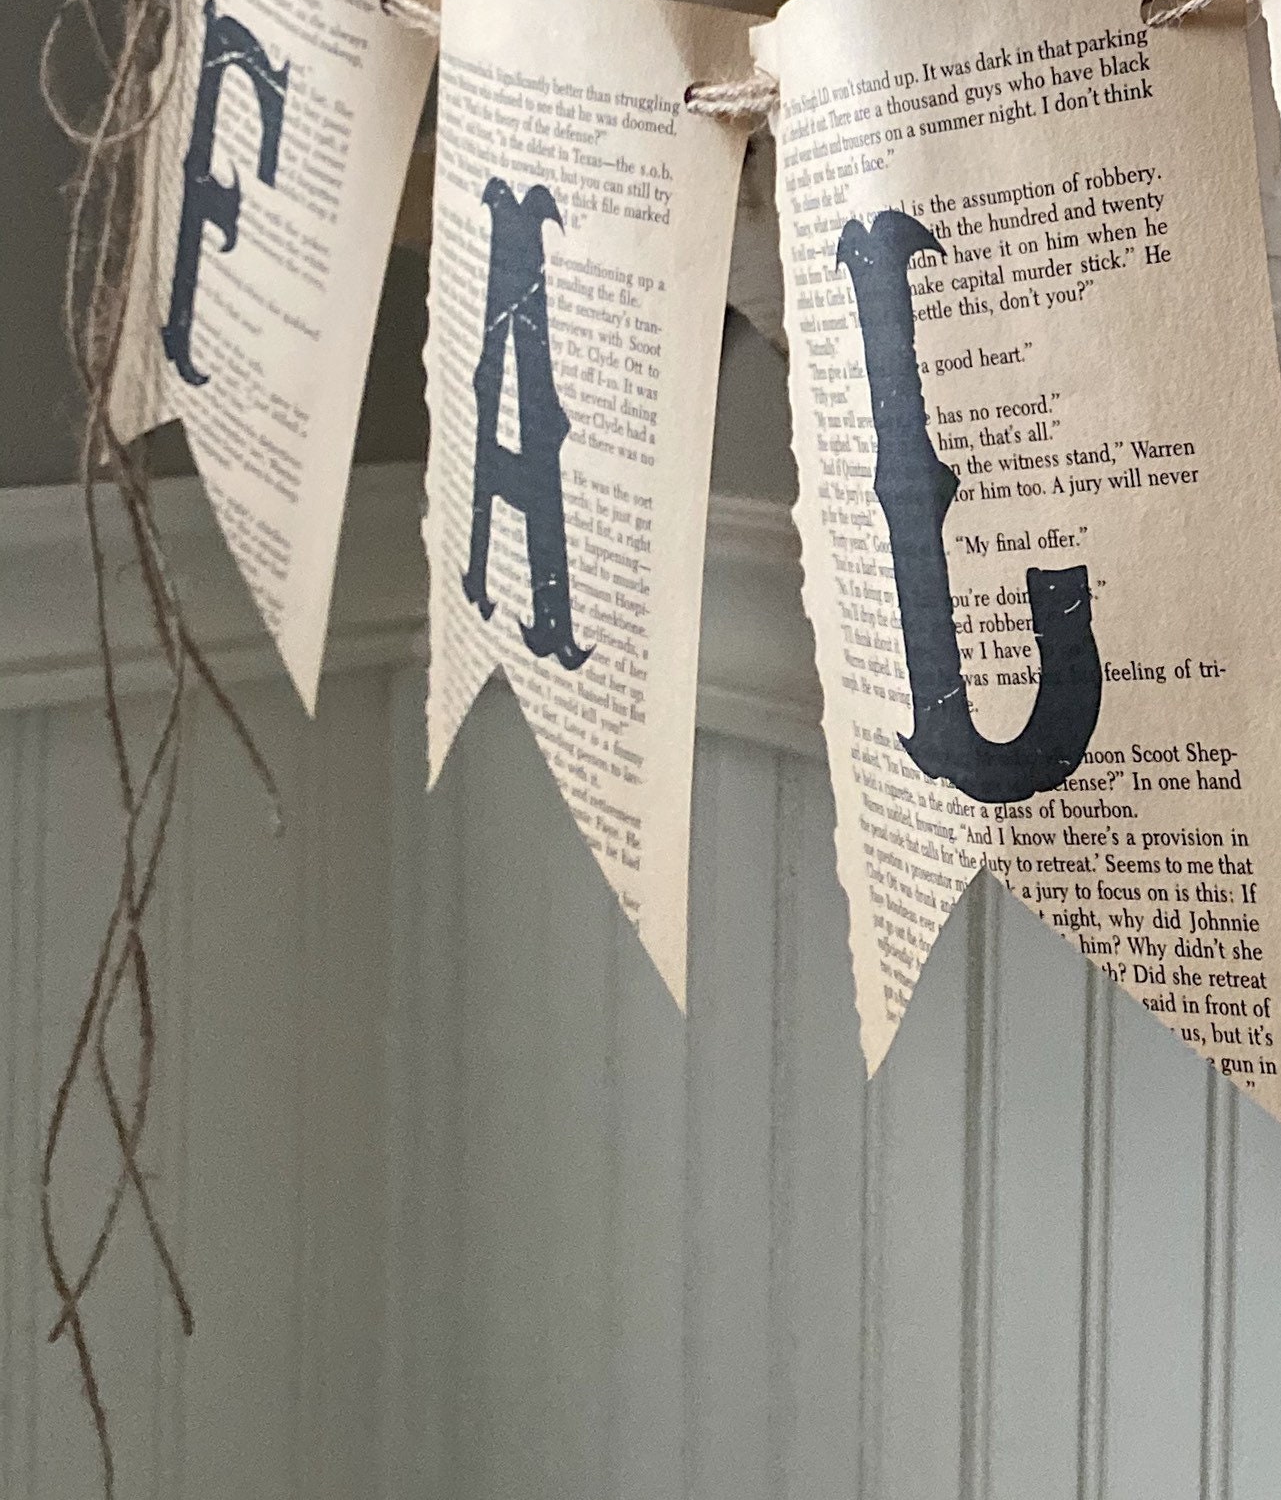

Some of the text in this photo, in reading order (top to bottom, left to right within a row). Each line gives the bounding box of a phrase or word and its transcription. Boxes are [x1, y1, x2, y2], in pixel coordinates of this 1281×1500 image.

[886, 50, 1150, 115] thousand guys who have black
[911, 165, 1161, 216] is the assumption of robbery.
[952, 216, 1168, 264] have it on him when he
[950, 264, 1004, 293] capital
[1011, 257, 1072, 282] murder
[1144, 243, 1171, 265] He
[934, 348, 973, 376] good
[935, 405, 963, 425] has
[968, 406, 989, 421] no
[966, 454, 992, 475] the
[997, 452, 1059, 471] witness
[1129, 439, 1195, 459] Warren
[462, 177, 596, 671] A
[836, 211, 1103, 803] L
[995, 529, 1031, 552] final
[1103, 657, 1226, 684] feeling of tri-
[1125, 832, 1136, 846] a
[1140, 827, 1223, 850] provision
[1230, 827, 1249, 847] in
[1051, 906, 1259, 934] night, why did Johnnie
[1132, 963, 1267, 990] Did she retreat
